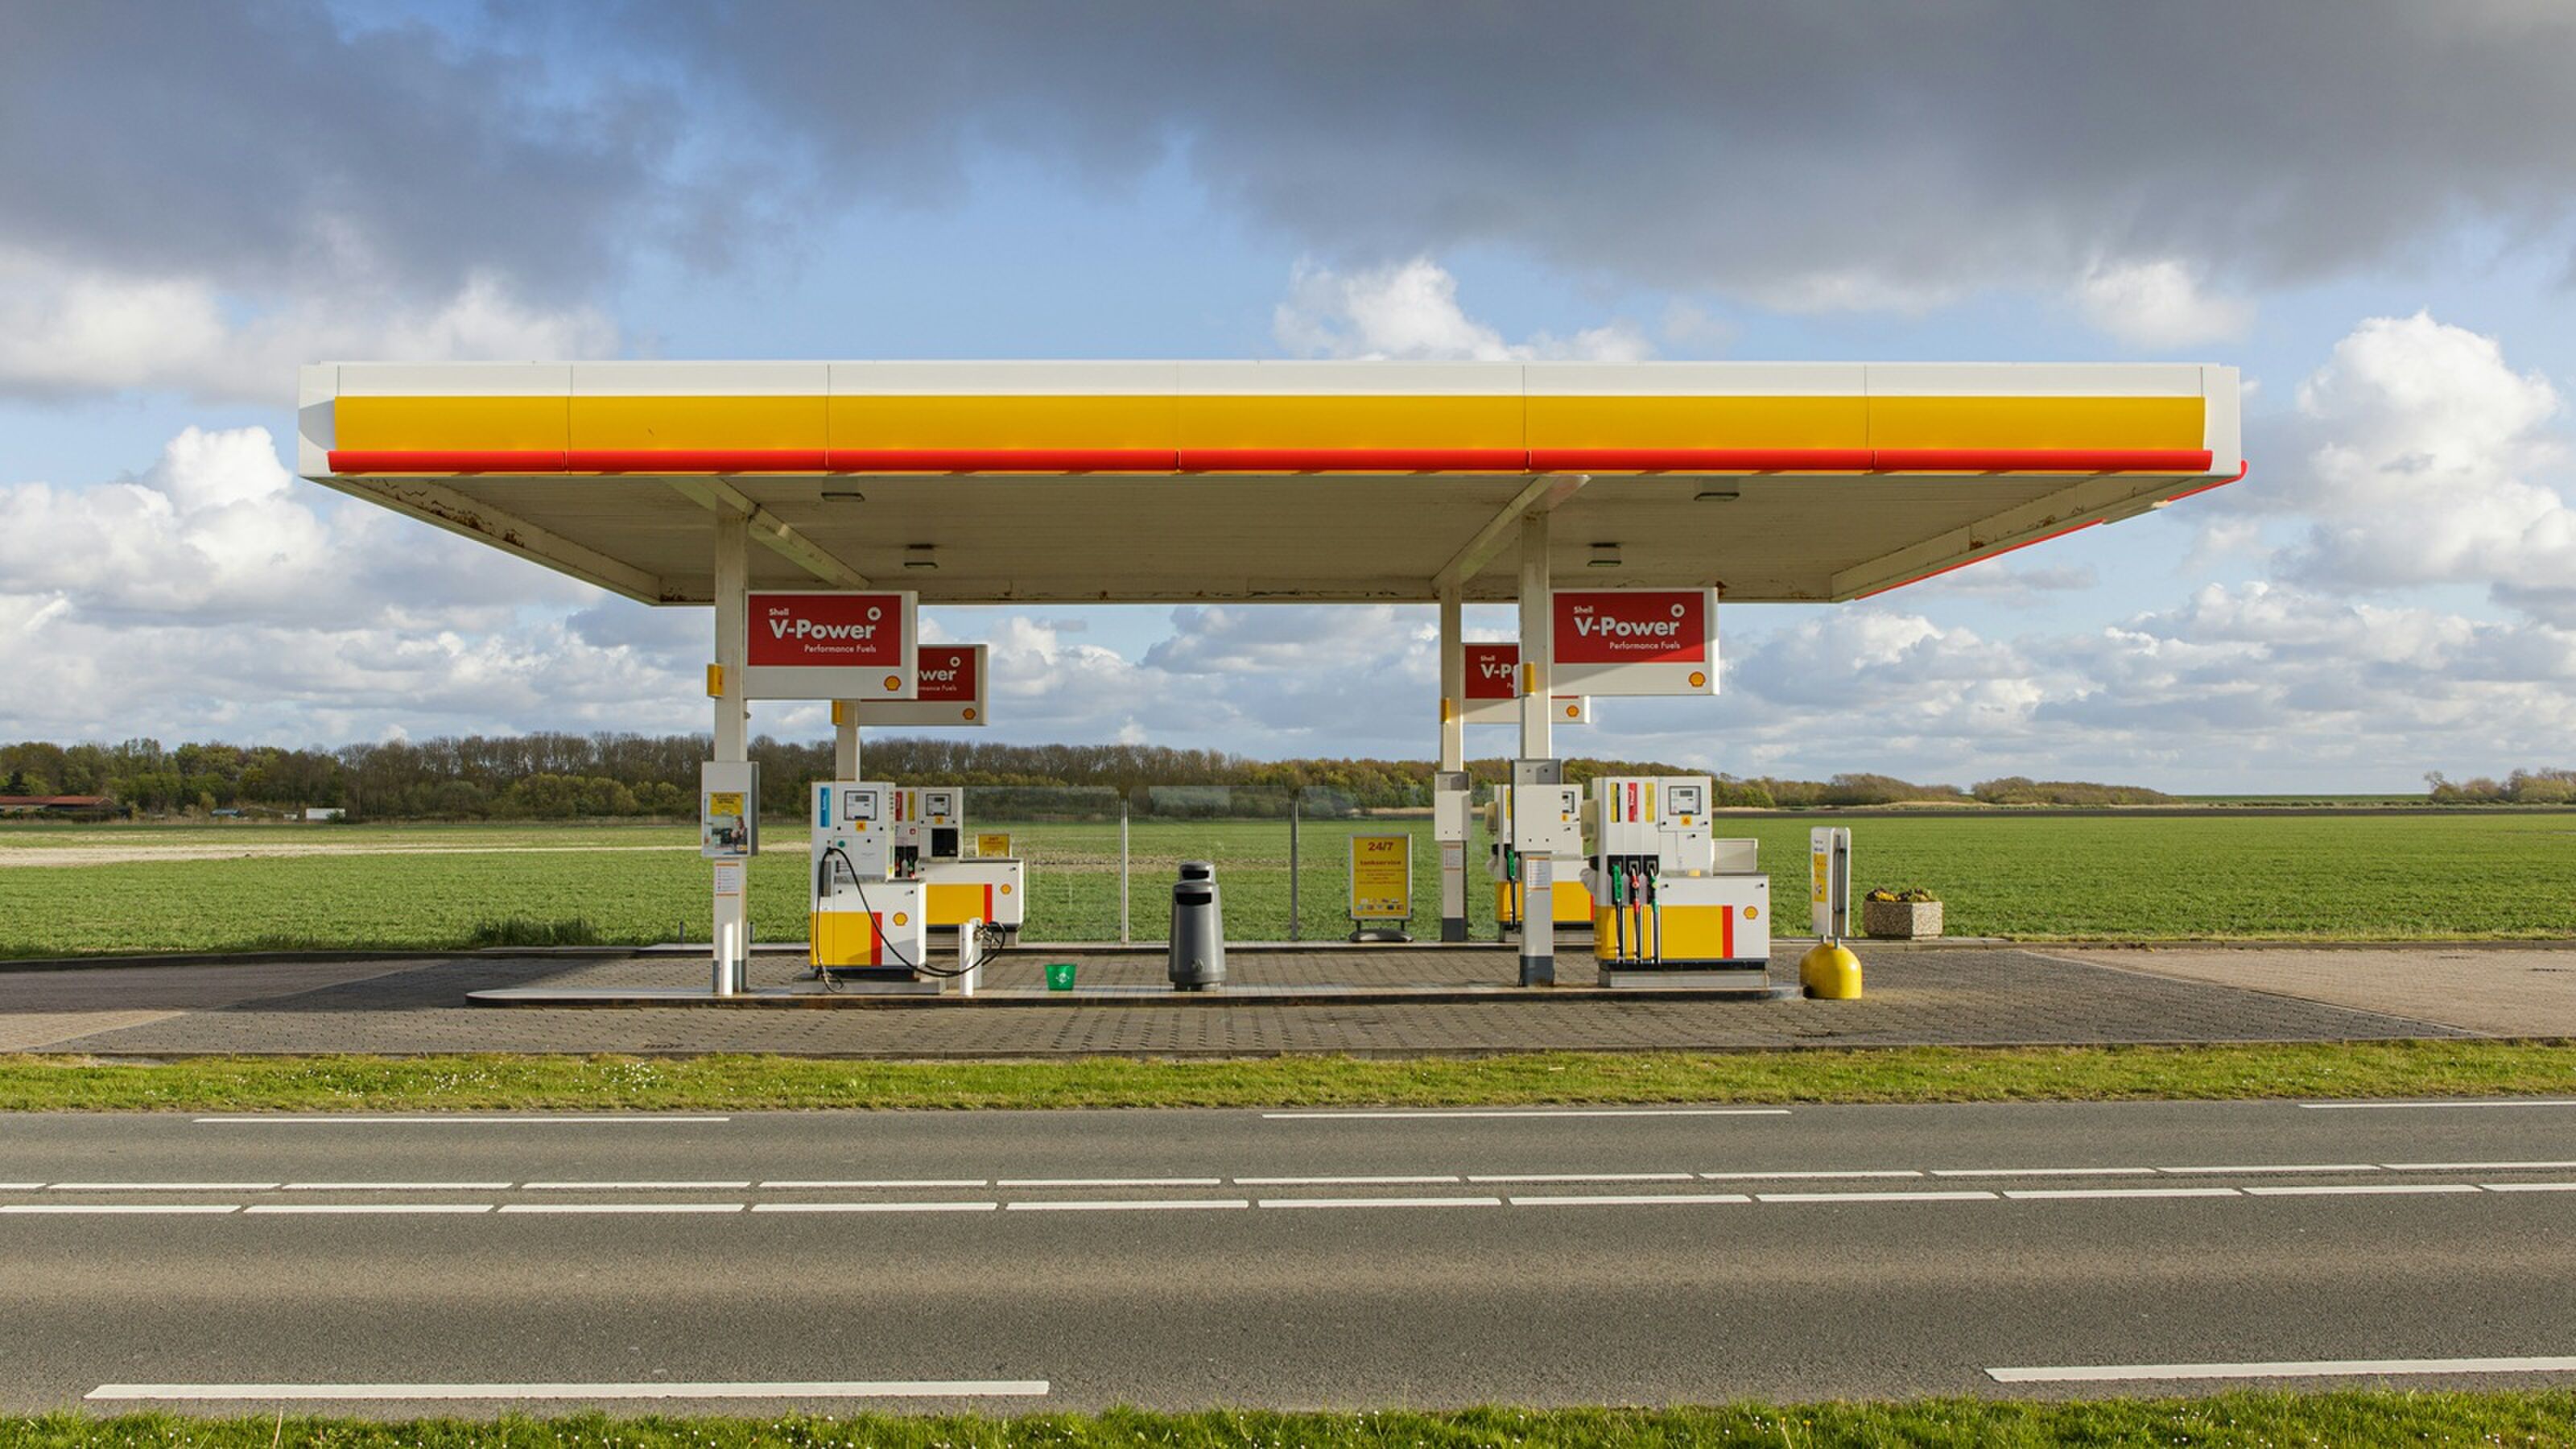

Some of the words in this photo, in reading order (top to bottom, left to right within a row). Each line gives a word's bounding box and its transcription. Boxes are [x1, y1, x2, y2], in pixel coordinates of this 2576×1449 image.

[769, 608, 790, 617] Shell
[1574, 605, 1594, 613] Shell
[769, 619, 877, 640] V-Power
[1574, 616, 1680, 637] V-Power
[804, 644, 855, 654] Performance
[857, 644, 877, 654] Fuels
[1609, 641, 1659, 650] Performance
[1661, 641, 1681, 650] Fuels
[1368, 841, 1394, 851] 24/7
